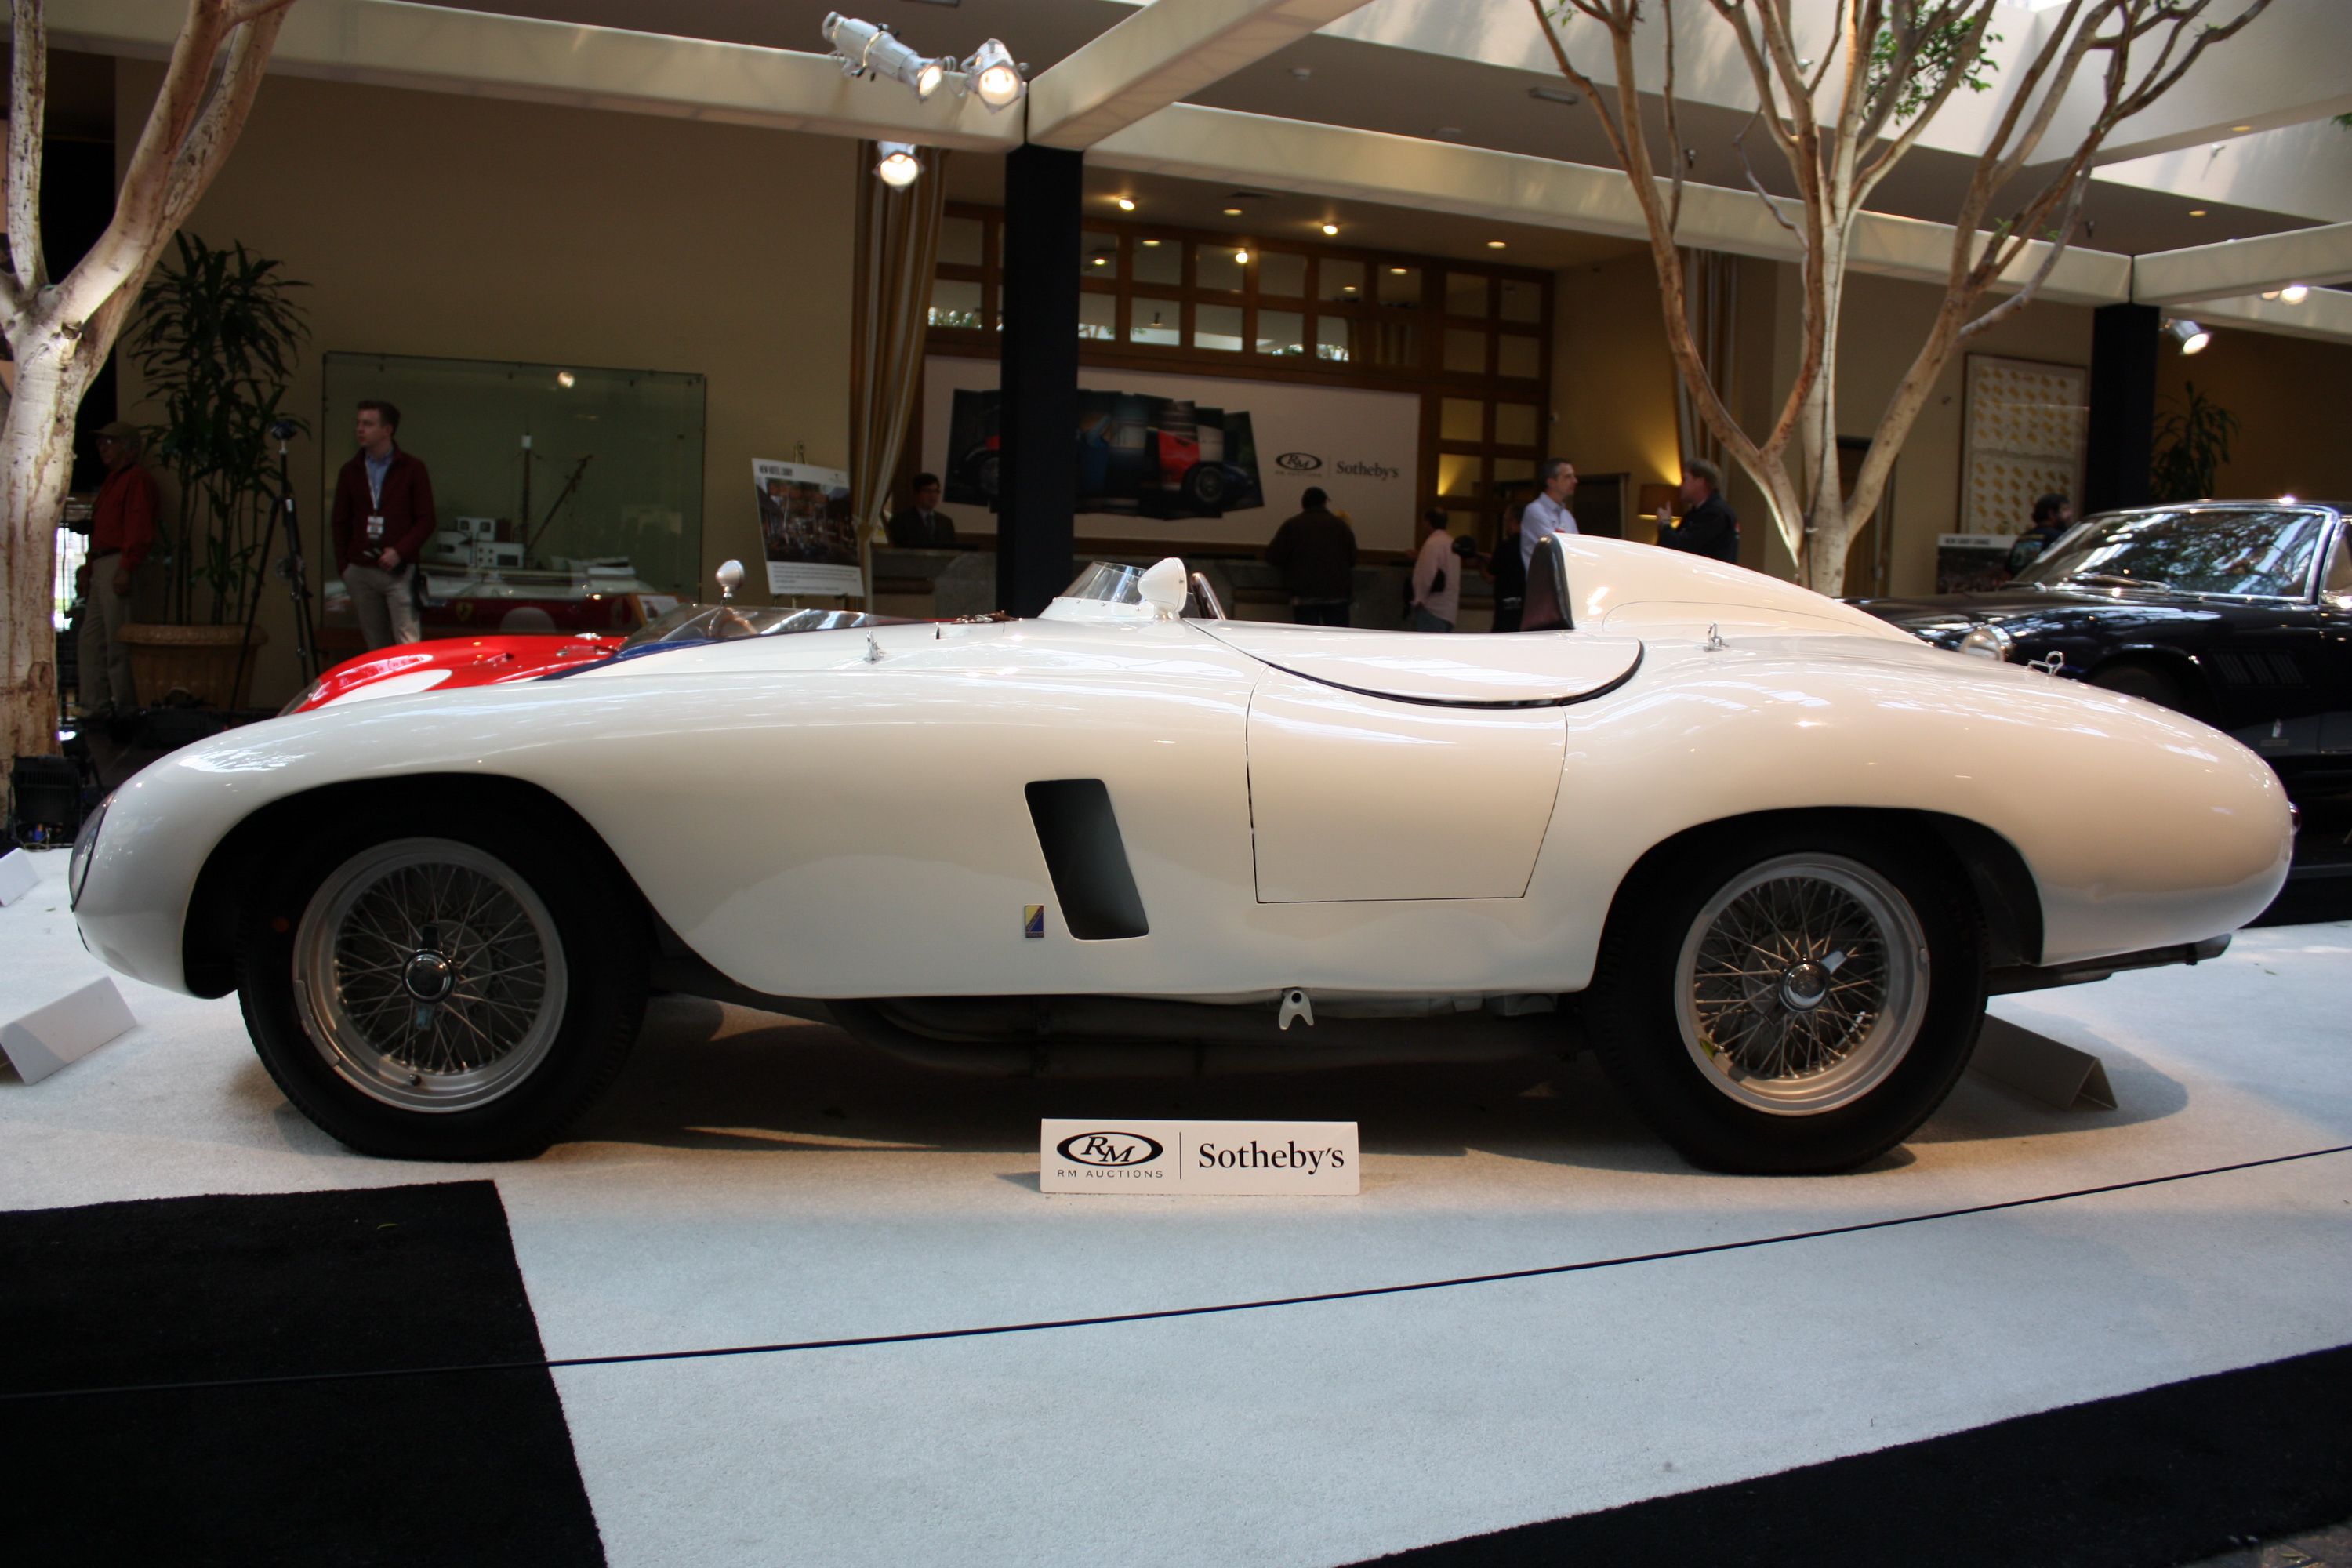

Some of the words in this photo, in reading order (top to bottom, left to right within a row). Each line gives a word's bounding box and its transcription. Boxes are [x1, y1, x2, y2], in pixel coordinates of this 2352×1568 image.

[1337, 461, 1399, 481] Sotheby's
[1080, 1136, 1135, 1162] RM
[1199, 1141, 1345, 1175] Sotheby's
[1086, 1169, 1163, 1178] AUCTIONS
